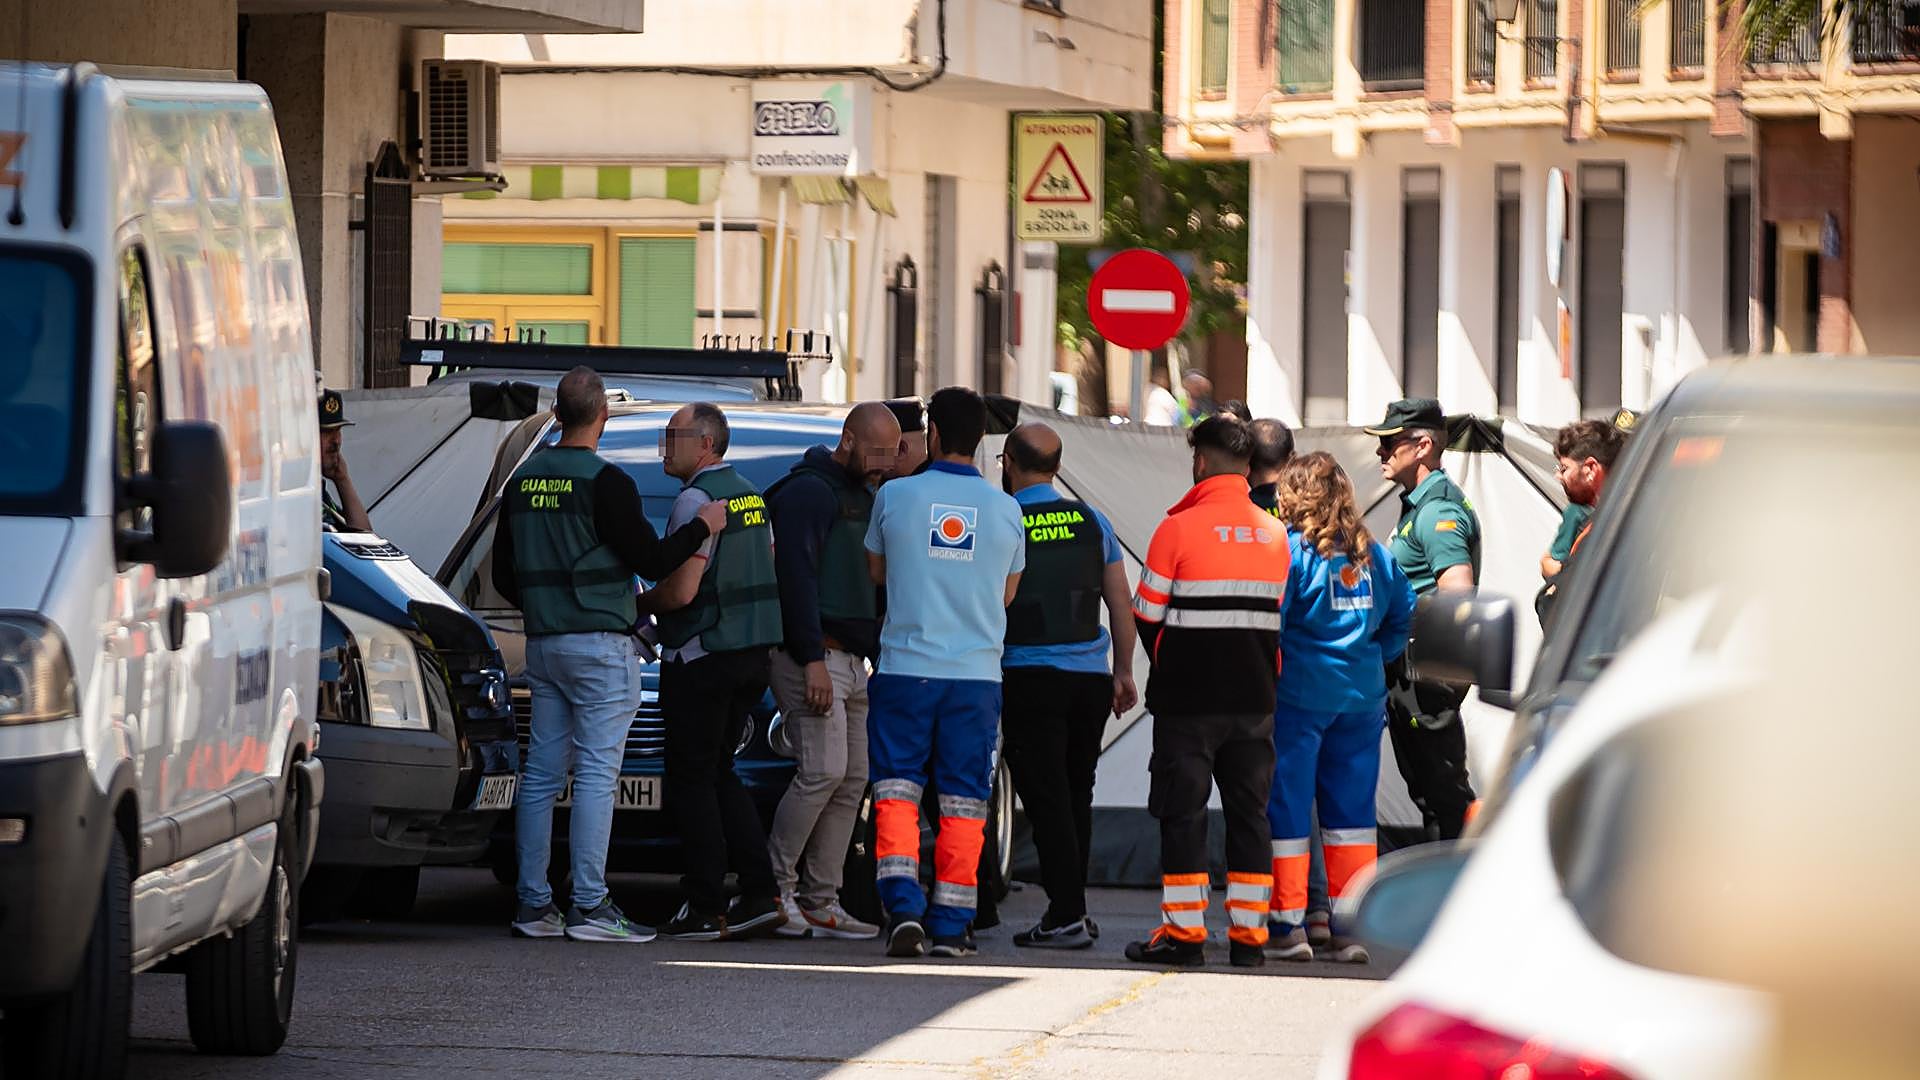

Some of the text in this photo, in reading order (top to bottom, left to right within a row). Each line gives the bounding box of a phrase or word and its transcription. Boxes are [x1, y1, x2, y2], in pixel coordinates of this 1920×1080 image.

[756, 151, 848, 166] confecciones
[1039, 209, 1077, 219] ZONA
[1025, 221, 1091, 232] ESCOLAR
[521, 478, 573, 493] GUARDIA
[531, 494, 561, 508] CIVIL
[729, 494, 766, 512] GUARDA
[744, 510, 765, 525] CVIL
[1023, 510, 1084, 528] UARDIA
[1030, 525, 1075, 542] CIVIL
[1214, 526, 1273, 544] TES
[928, 549, 974, 561] URGENCIAS
